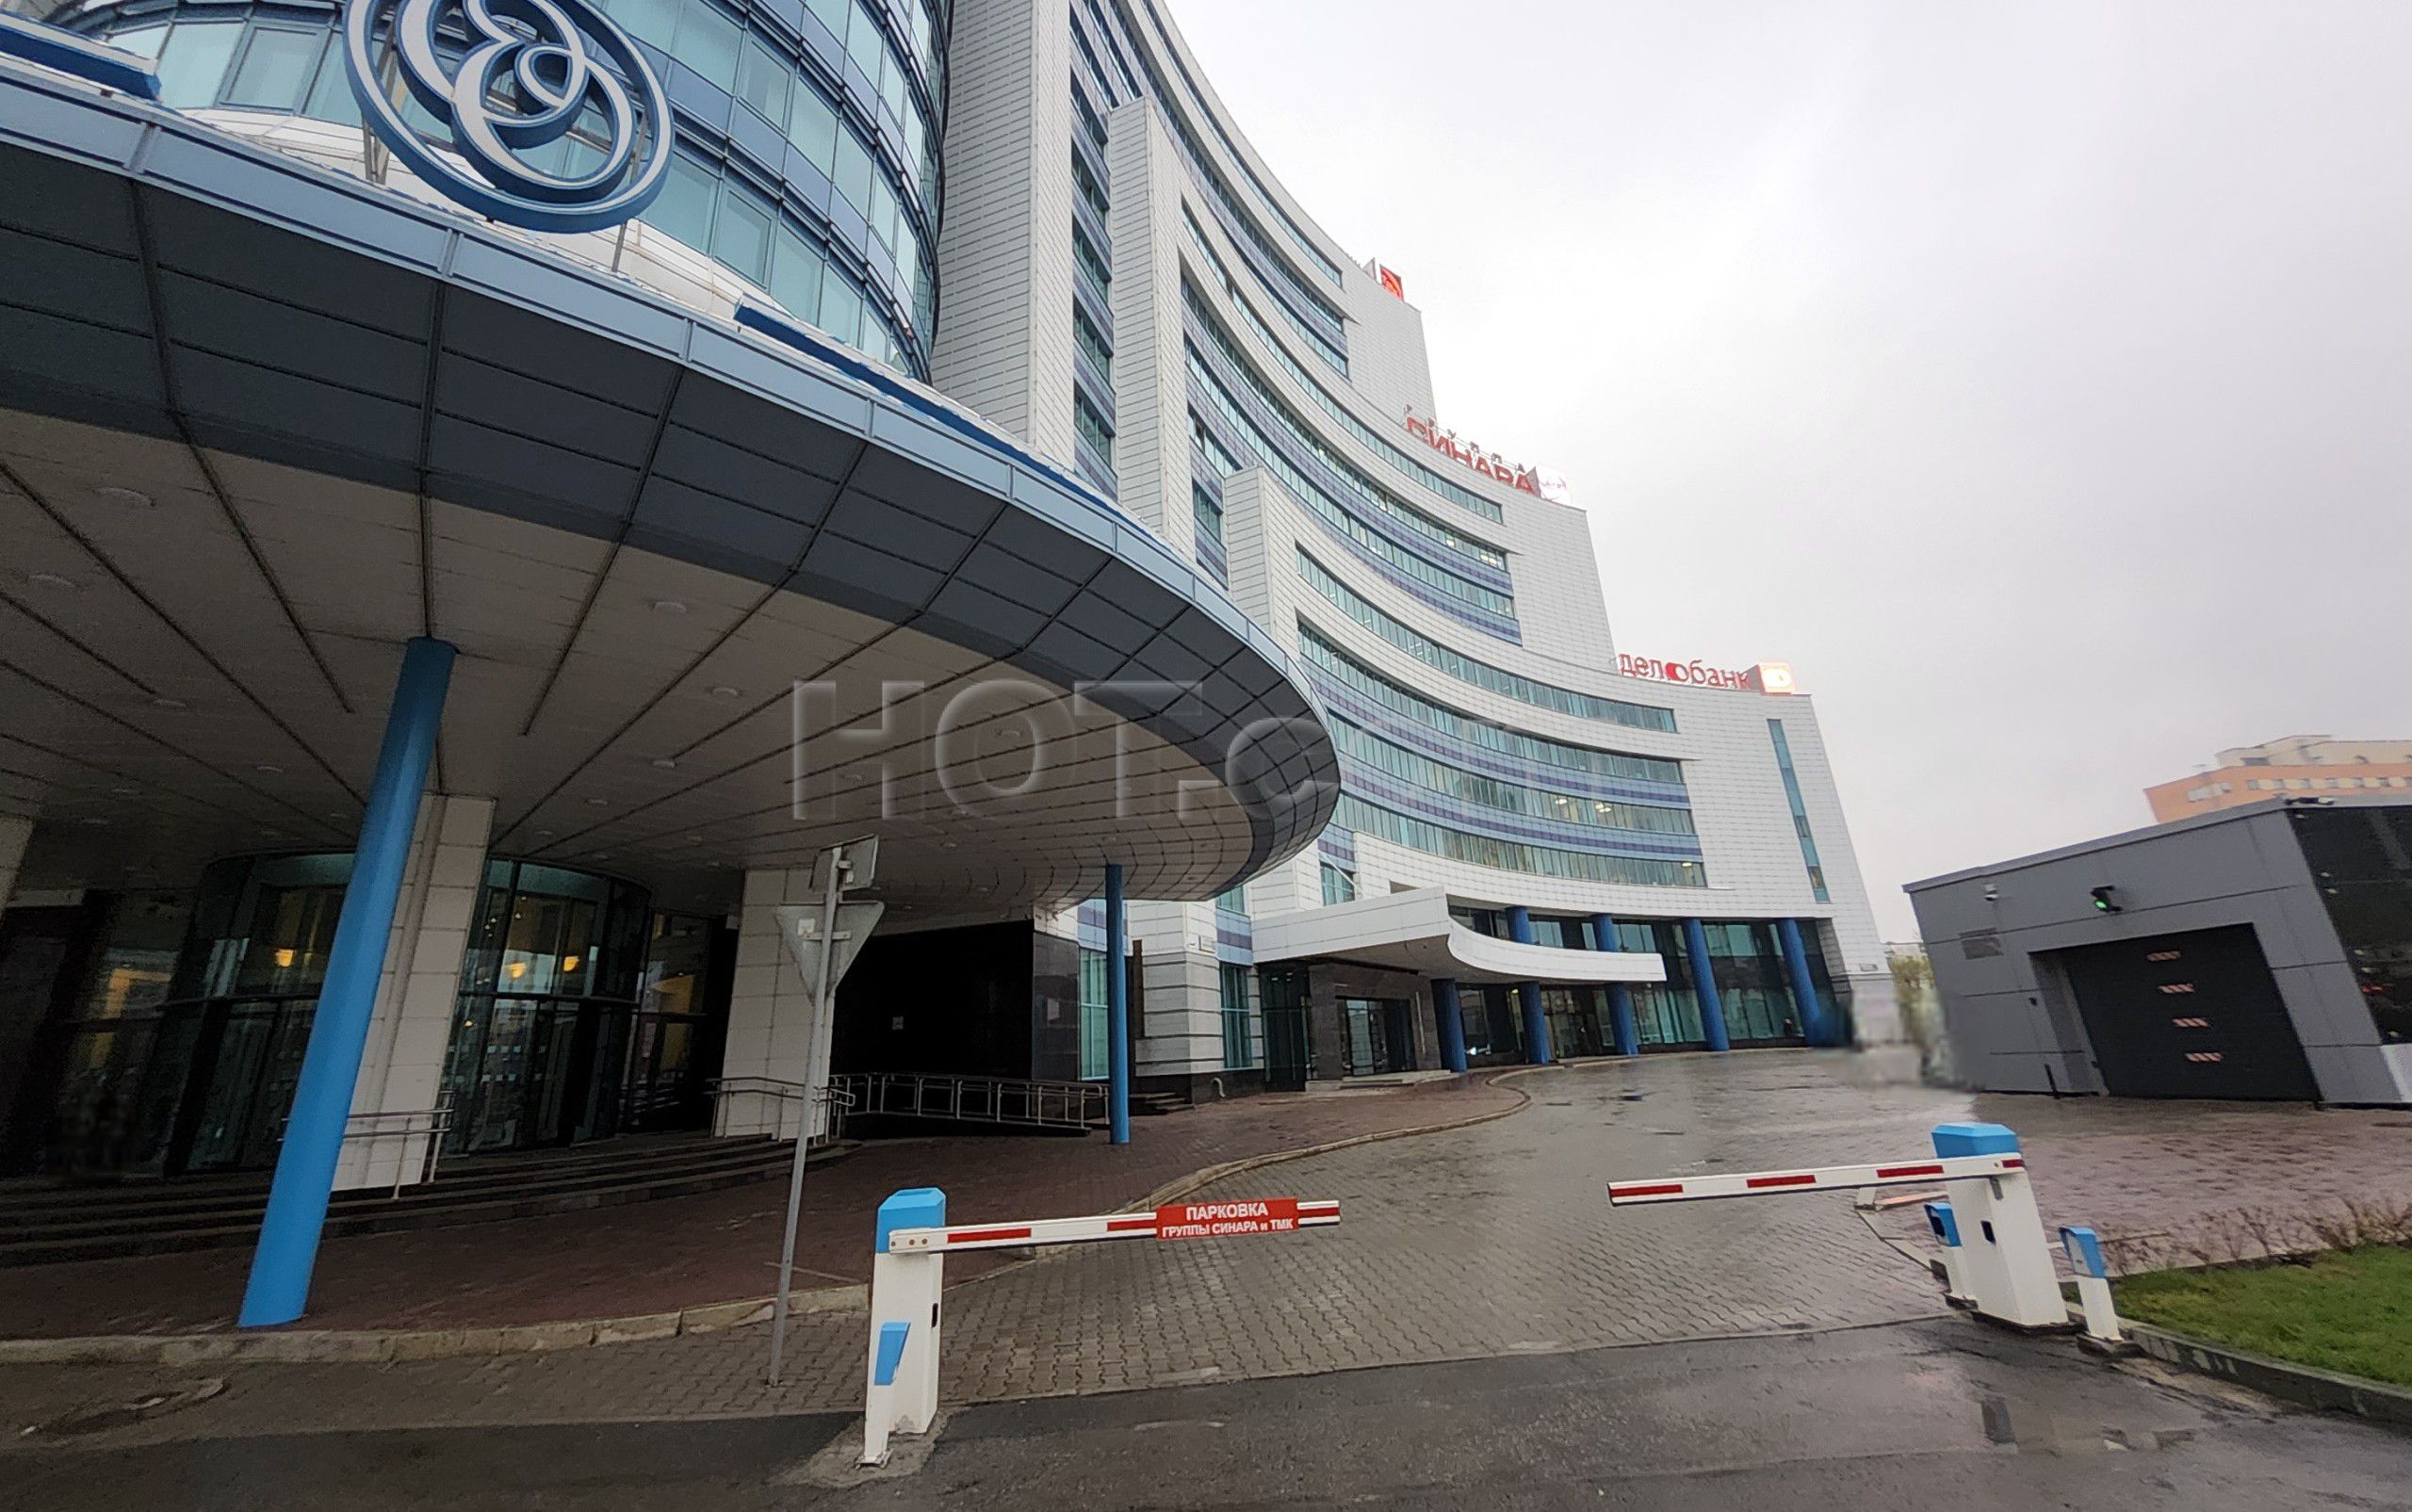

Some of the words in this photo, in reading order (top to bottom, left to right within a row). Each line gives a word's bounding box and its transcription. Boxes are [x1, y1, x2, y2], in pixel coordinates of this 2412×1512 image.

[1185, 1202, 1269, 1221] ПАРКОВКА
[1162, 1225, 1211, 1238] ГРУППЫ
[1212, 1221, 1259, 1235] СИНАРА
[1260, 1222, 1268, 1231] и
[1270, 1218, 1294, 1230] ТМК
